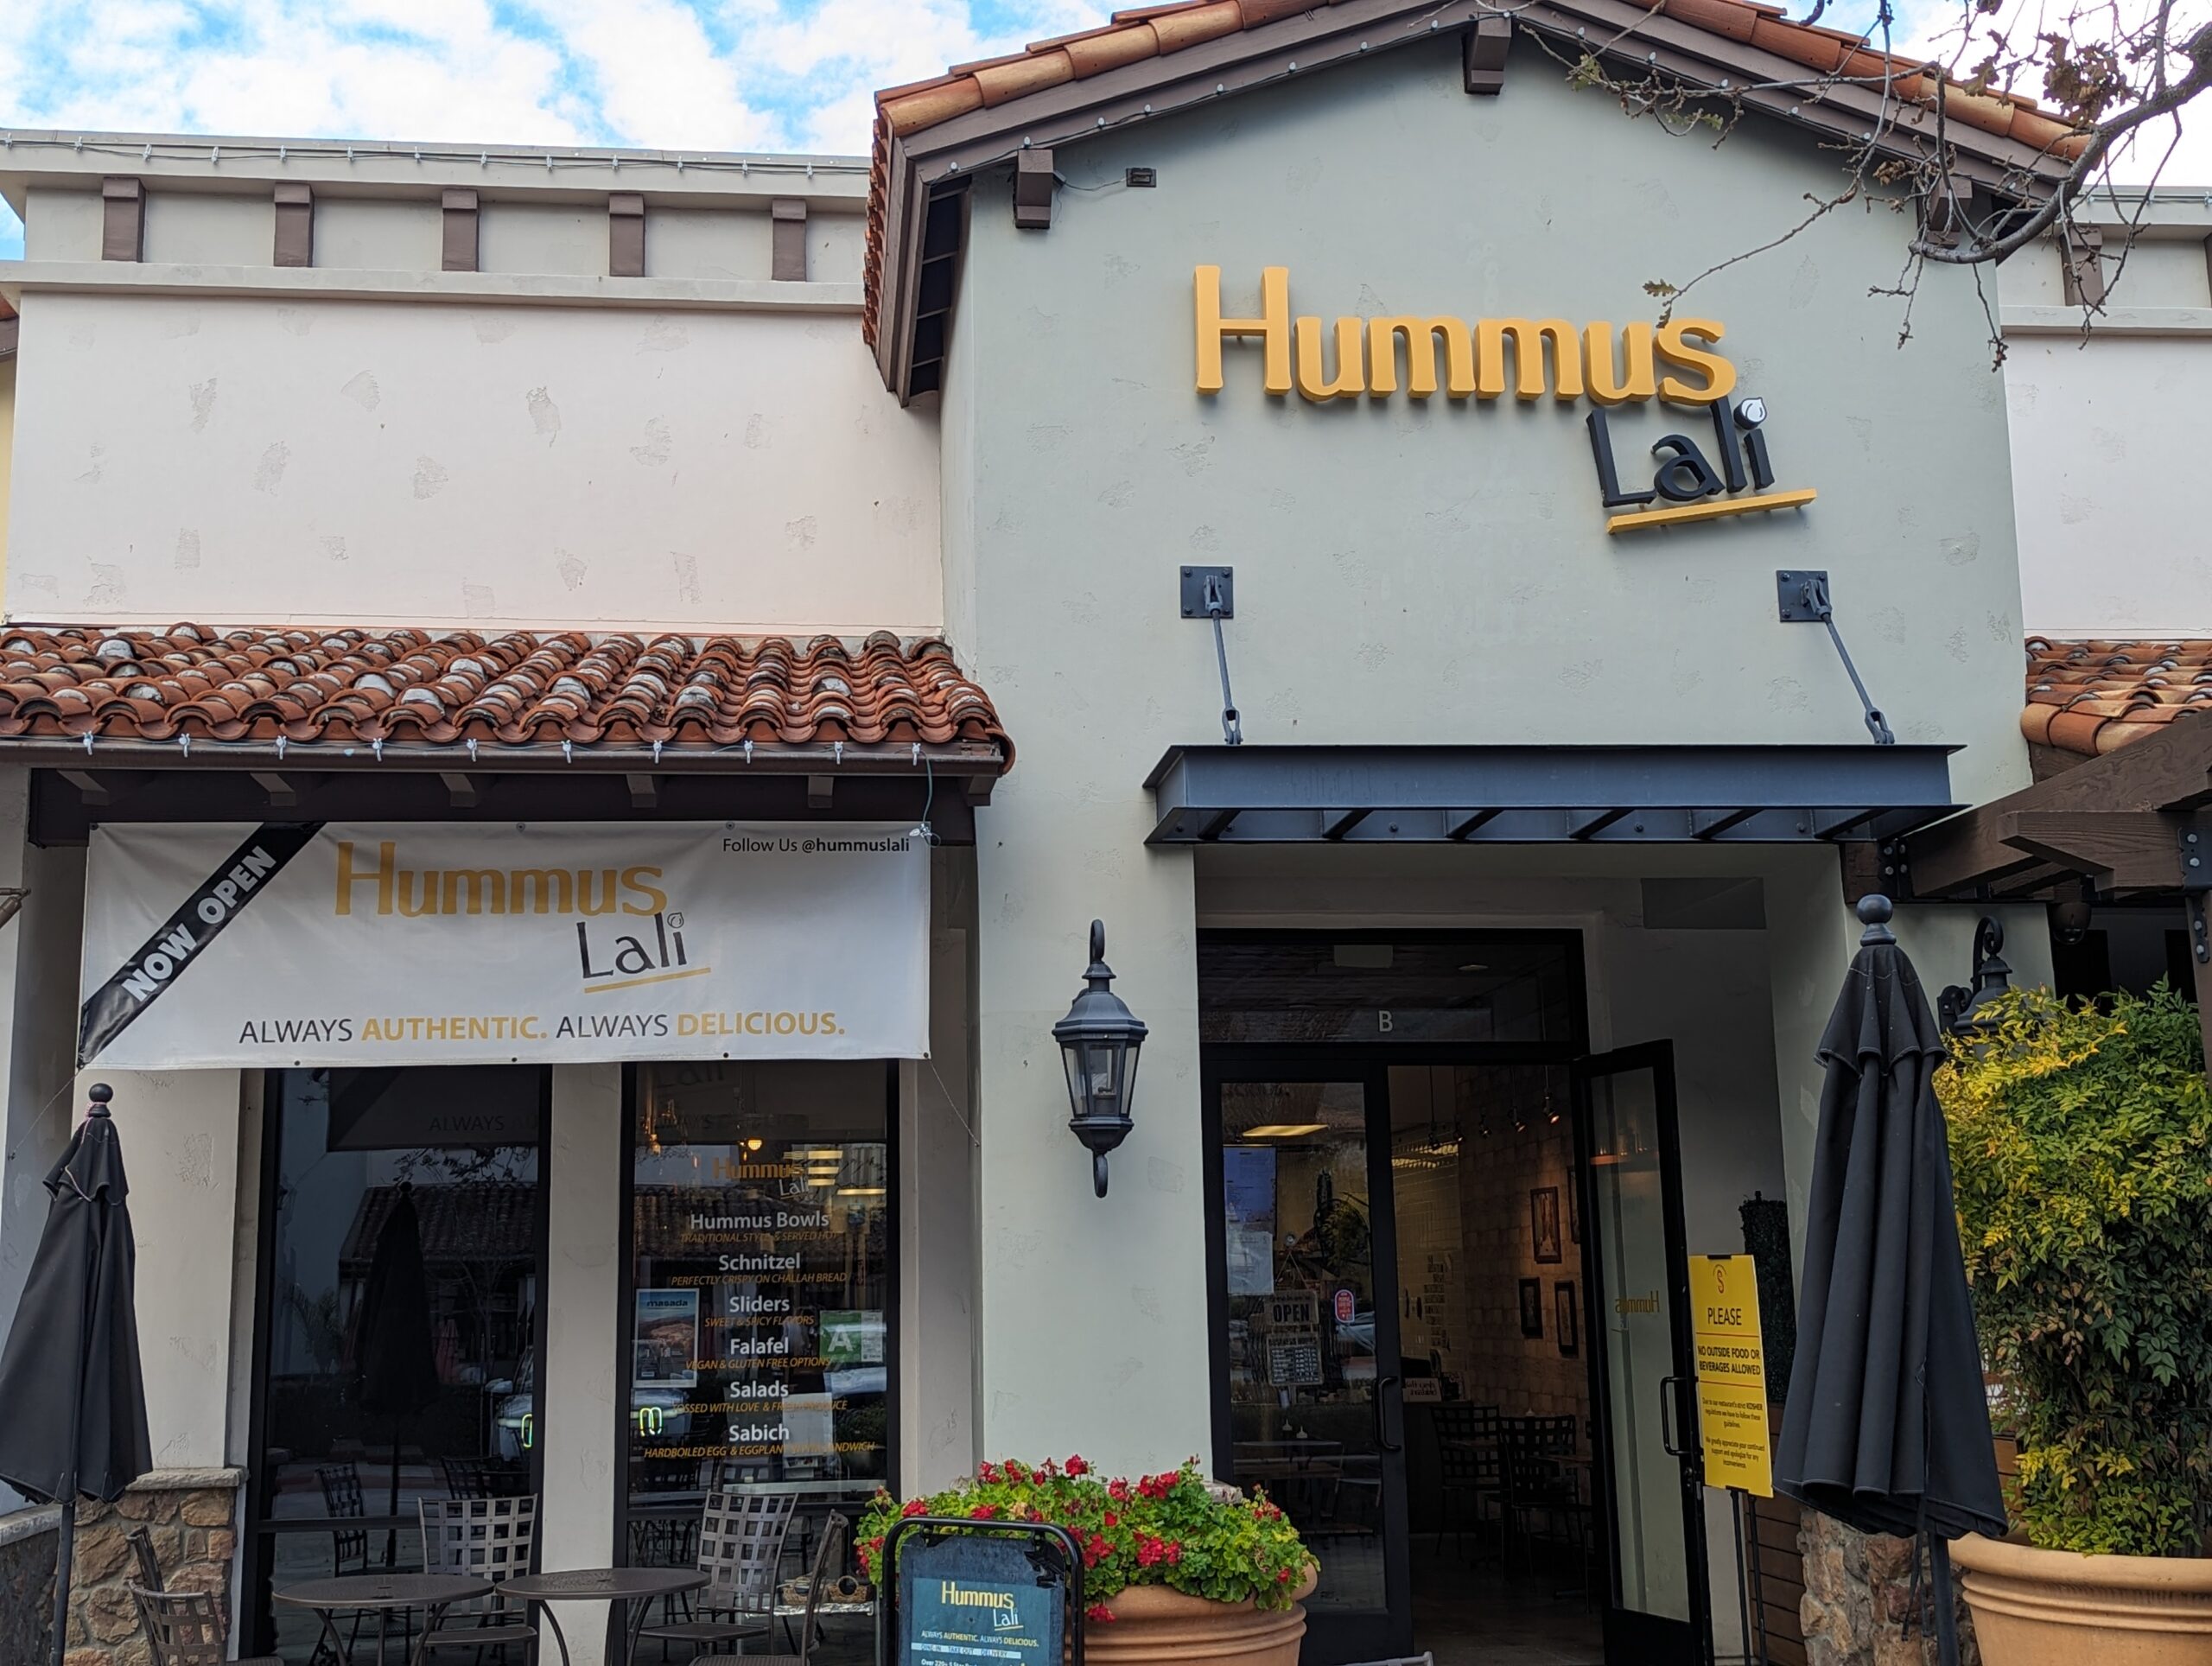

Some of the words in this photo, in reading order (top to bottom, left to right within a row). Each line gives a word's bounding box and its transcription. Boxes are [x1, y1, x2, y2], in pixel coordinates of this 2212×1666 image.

[1193, 265, 1737, 405] Hummus
[1586, 395, 1775, 508] Lali
[723, 837, 774, 852] Follow
[779, 838, 798, 852] Us
[802, 837, 910, 854] @hummuslali
[335, 842, 667, 918] Hummus
[121, 922, 198, 1002] NOW
[197, 845, 276, 925] OPEN
[576, 911, 688, 980] Lali
[239, 1018, 353, 1044] ALWAYS
[360, 1015, 548, 1042] AUTHENTIC.
[556, 1014, 669, 1039] ALWAYS
[677, 1011, 846, 1038] DELICIOUS.
[1377, 1010, 1394, 1033] B
[712, 1156, 804, 1180] Hummus
[779, 1177, 810, 1197] Lali
[690, 1213, 772, 1230] Hummus
[777, 1211, 830, 1228] Bowls
[680, 1232, 741, 1243] TRADITIONAL
[781, 1230, 817, 1241] SERVED
[719, 1252, 801, 1270] Schnitzel
[671, 1275, 721, 1286] PERFECTLY
[722, 1274, 754, 1285] CRISPY
[755, 1274, 771, 1283] ON
[772, 1273, 814, 1283] CHALLAH
[816, 1272, 848, 1282] BREAD
[729, 1295, 791, 1313] Sliders
[1273, 1304, 1309, 1322] OPEN
[704, 1316, 734, 1327] SWEET
[736, 1316, 744, 1326] &
[746, 1316, 771, 1326] SPICY
[772, 1315, 815, 1326] FLAVORS
[1707, 1307, 1742, 1326] PLEASE
[729, 1337, 789, 1355] Falafel
[827, 1324, 854, 1352] A
[1698, 1345, 1706, 1356] NO
[1707, 1346, 1731, 1358] OUTSIDE
[1732, 1347, 1750, 1358] FOOD
[1751, 1349, 1760, 1359] OR
[685, 1360, 719, 1370] VEGAN
[719, 1359, 727, 1369] &
[728, 1358, 765, 1369] GLUTEN
[766, 1358, 788, 1368] FREE
[790, 1357, 830, 1367] OPTIONS
[1699, 1360, 1730, 1373] BEVERAGES
[1731, 1363, 1761, 1376] ALLOWED
[729, 1380, 789, 1398] Salads
[672, 1403, 708, 1414] TOSSED
[709, 1402, 733, 1413] WITH
[735, 1402, 760, 1412] LOVE
[763, 1402, 771, 1411] &
[728, 1424, 790, 1442] Sabich
[644, 1447, 705, 1459] HARDBOILED
[707, 1447, 727, 1457] EGG
[730, 1446, 738, 1456] &
[941, 1580, 1014, 1610] Hummus
[993, 1607, 1019, 1626] Lali
[921, 1630, 943, 1639] ALWAYS
[944, 1631, 979, 1642] AUTHENTIC.
[980, 1634, 1003, 1644] ALWAYS
[1003, 1636, 1039, 1647] DELICIOUS.
